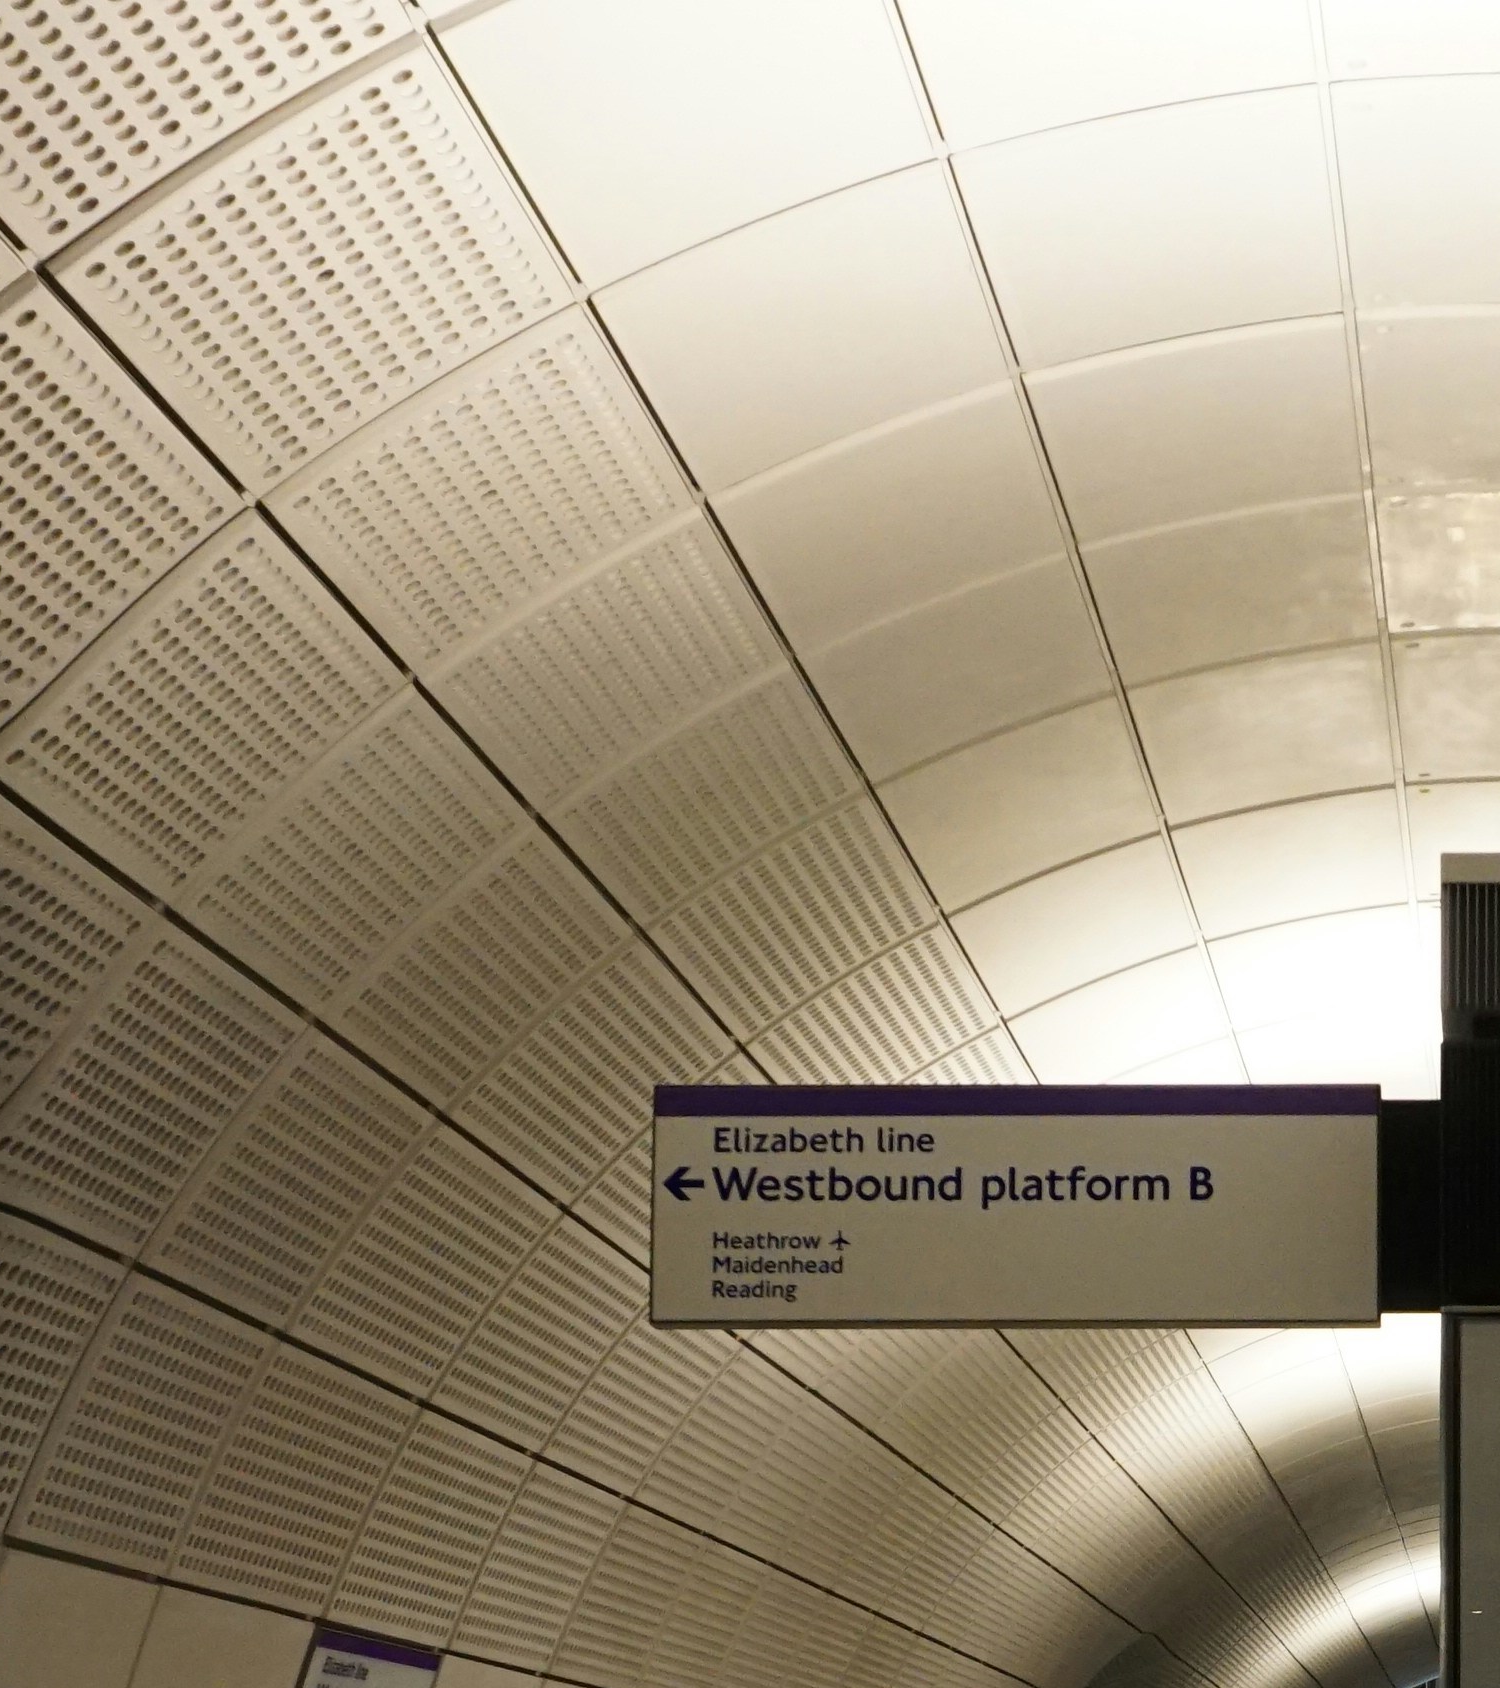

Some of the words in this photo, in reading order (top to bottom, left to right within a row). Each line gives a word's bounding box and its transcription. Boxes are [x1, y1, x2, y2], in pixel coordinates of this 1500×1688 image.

[713, 1126, 864, 1154] Elizabeth
[878, 1126, 935, 1154] line
[712, 1166, 964, 1203] Westbound
[981, 1165, 1171, 1210] platform
[1189, 1166, 1215, 1202] B
[712, 1231, 822, 1250] Heathrow
[712, 1255, 844, 1274] Maidenhead
[711, 1279, 798, 1303] Reading
